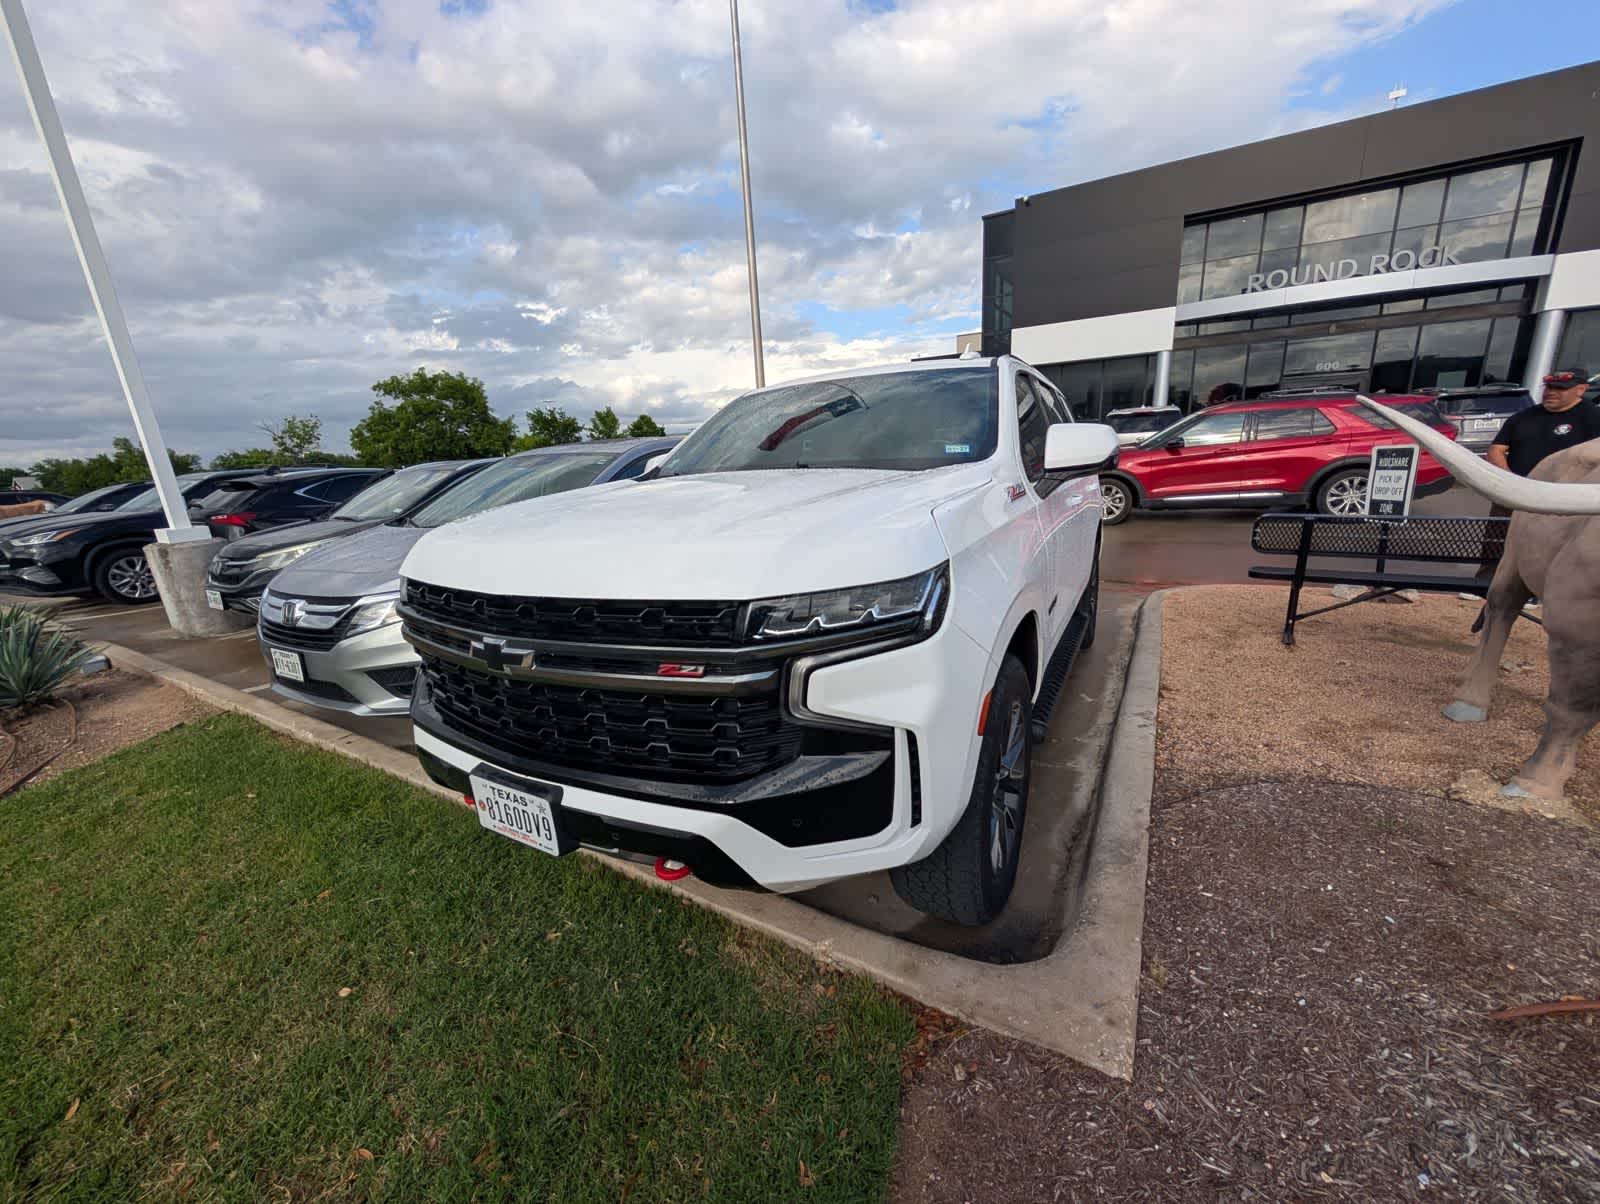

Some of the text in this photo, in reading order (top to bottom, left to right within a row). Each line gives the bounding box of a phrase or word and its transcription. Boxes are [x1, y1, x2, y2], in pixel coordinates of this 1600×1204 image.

[1246, 245, 1463, 293] ROUND ROCK
[1315, 360, 1341, 371] 600
[1379, 457, 1409, 467] RIDESHARE
[1379, 475, 1403, 483] PICK UP
[1375, 486, 1405, 496] DROP OFF
[1379, 503, 1394, 513] ZONE
[489, 785, 528, 807] TEXAS
